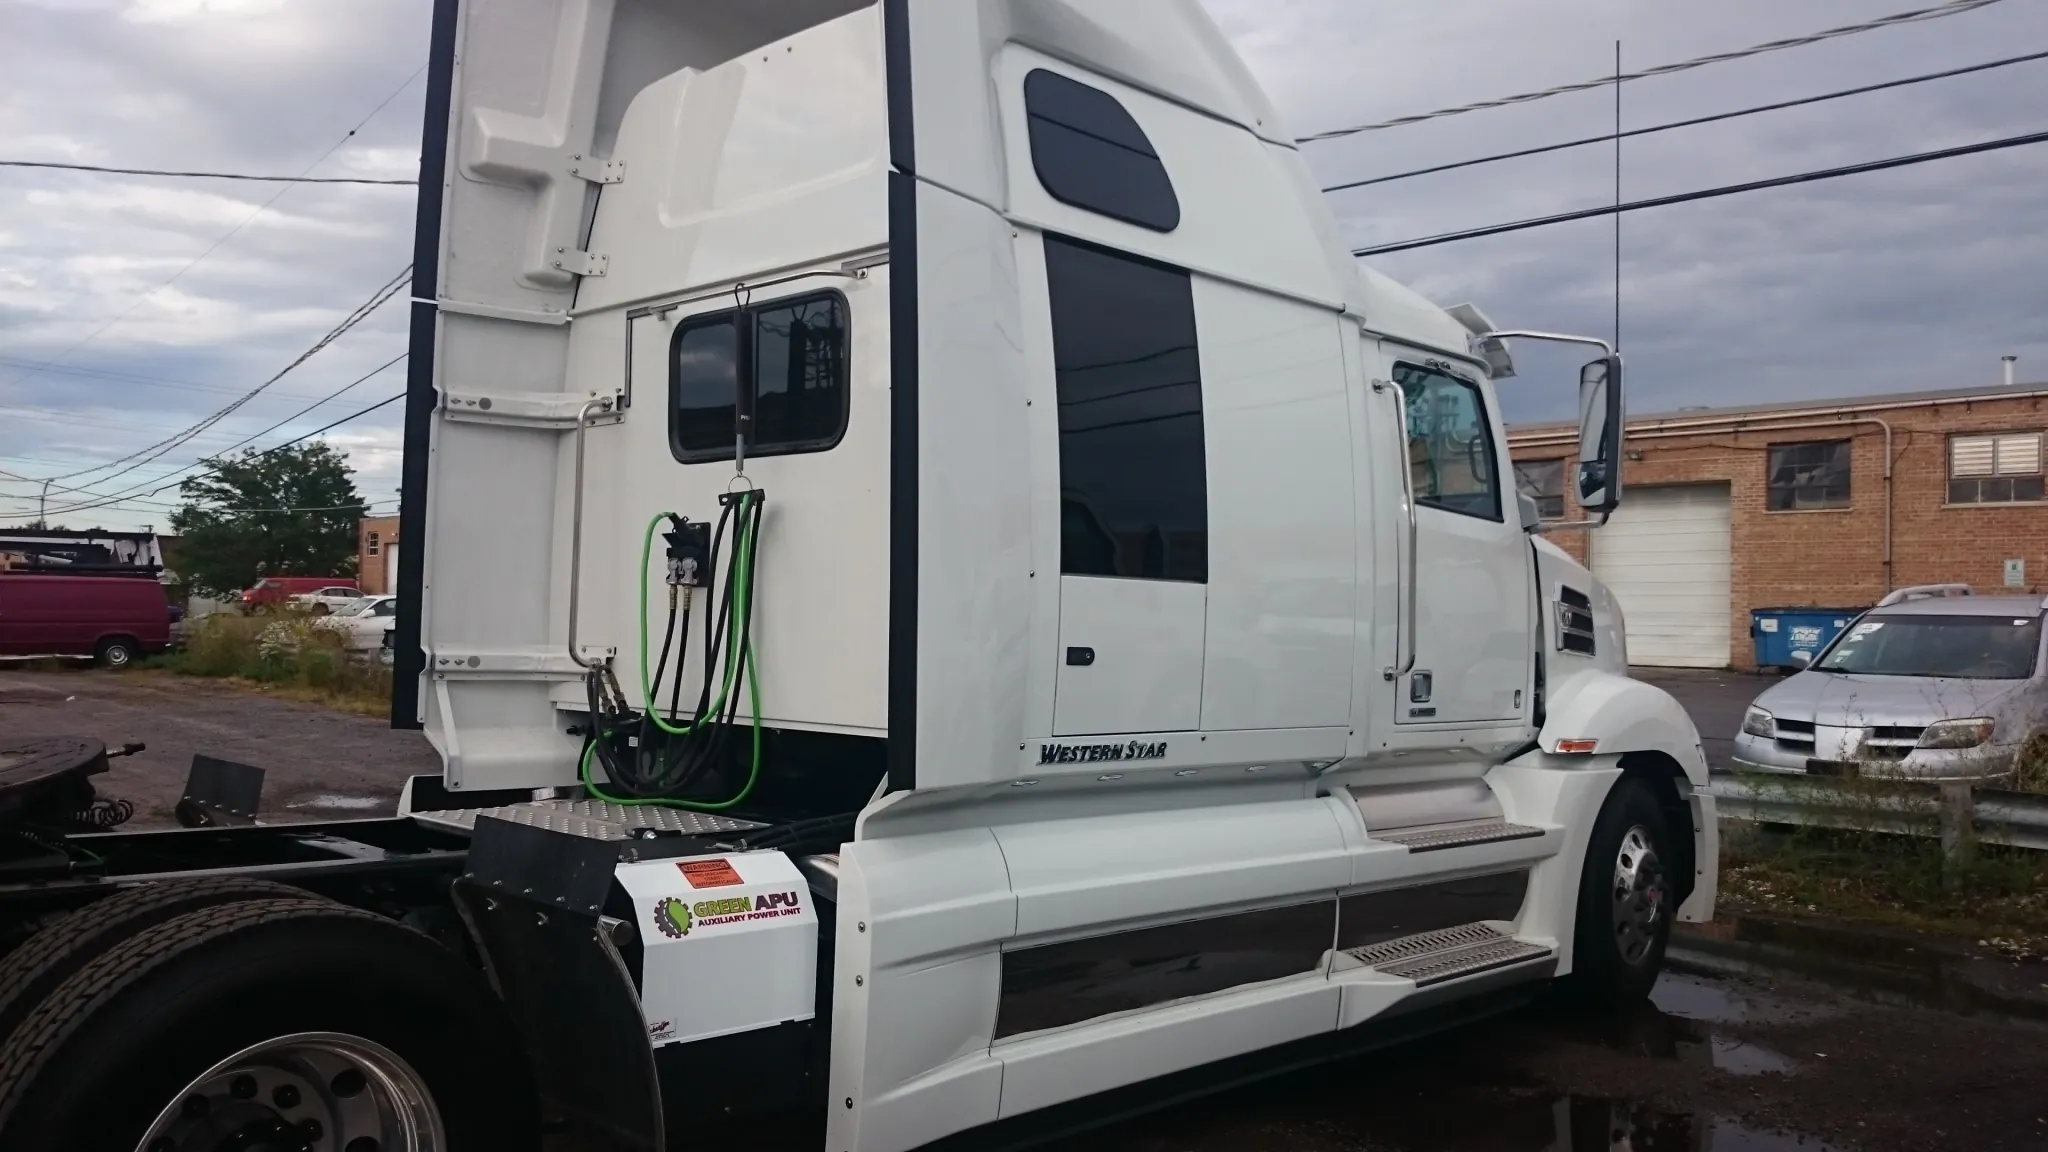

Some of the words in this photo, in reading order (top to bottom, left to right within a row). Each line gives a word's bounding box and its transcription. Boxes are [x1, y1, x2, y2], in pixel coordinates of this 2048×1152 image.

[1037, 744, 1124, 765] WESTERN
[1124, 740, 1167, 760] STAR
[683, 861, 726, 870] WARNING
[693, 896, 752, 917] GREEN
[755, 891, 799, 911] APU
[698, 914, 745, 927] AUXILIARY
[748, 910, 779, 920] POWER
[780, 907, 801, 916] UNIT
